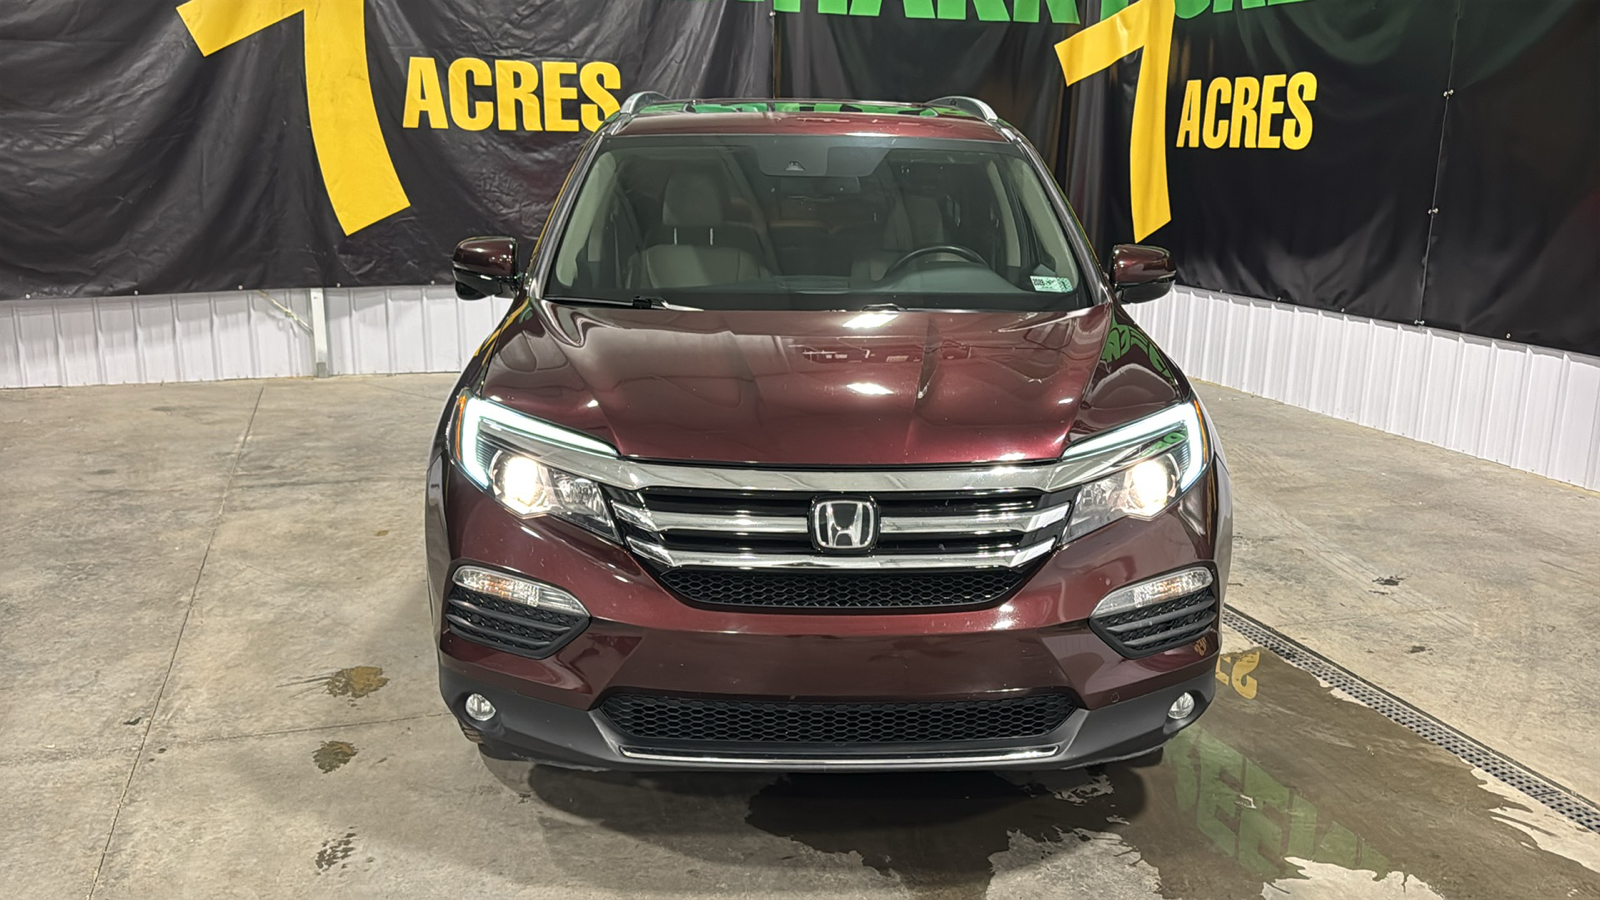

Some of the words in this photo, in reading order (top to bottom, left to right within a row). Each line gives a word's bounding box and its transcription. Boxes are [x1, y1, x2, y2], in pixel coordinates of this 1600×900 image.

[403, 57, 622, 134] ACRES
[1054, 0, 1175, 242] 7
[1176, 71, 1318, 150] ACRES
